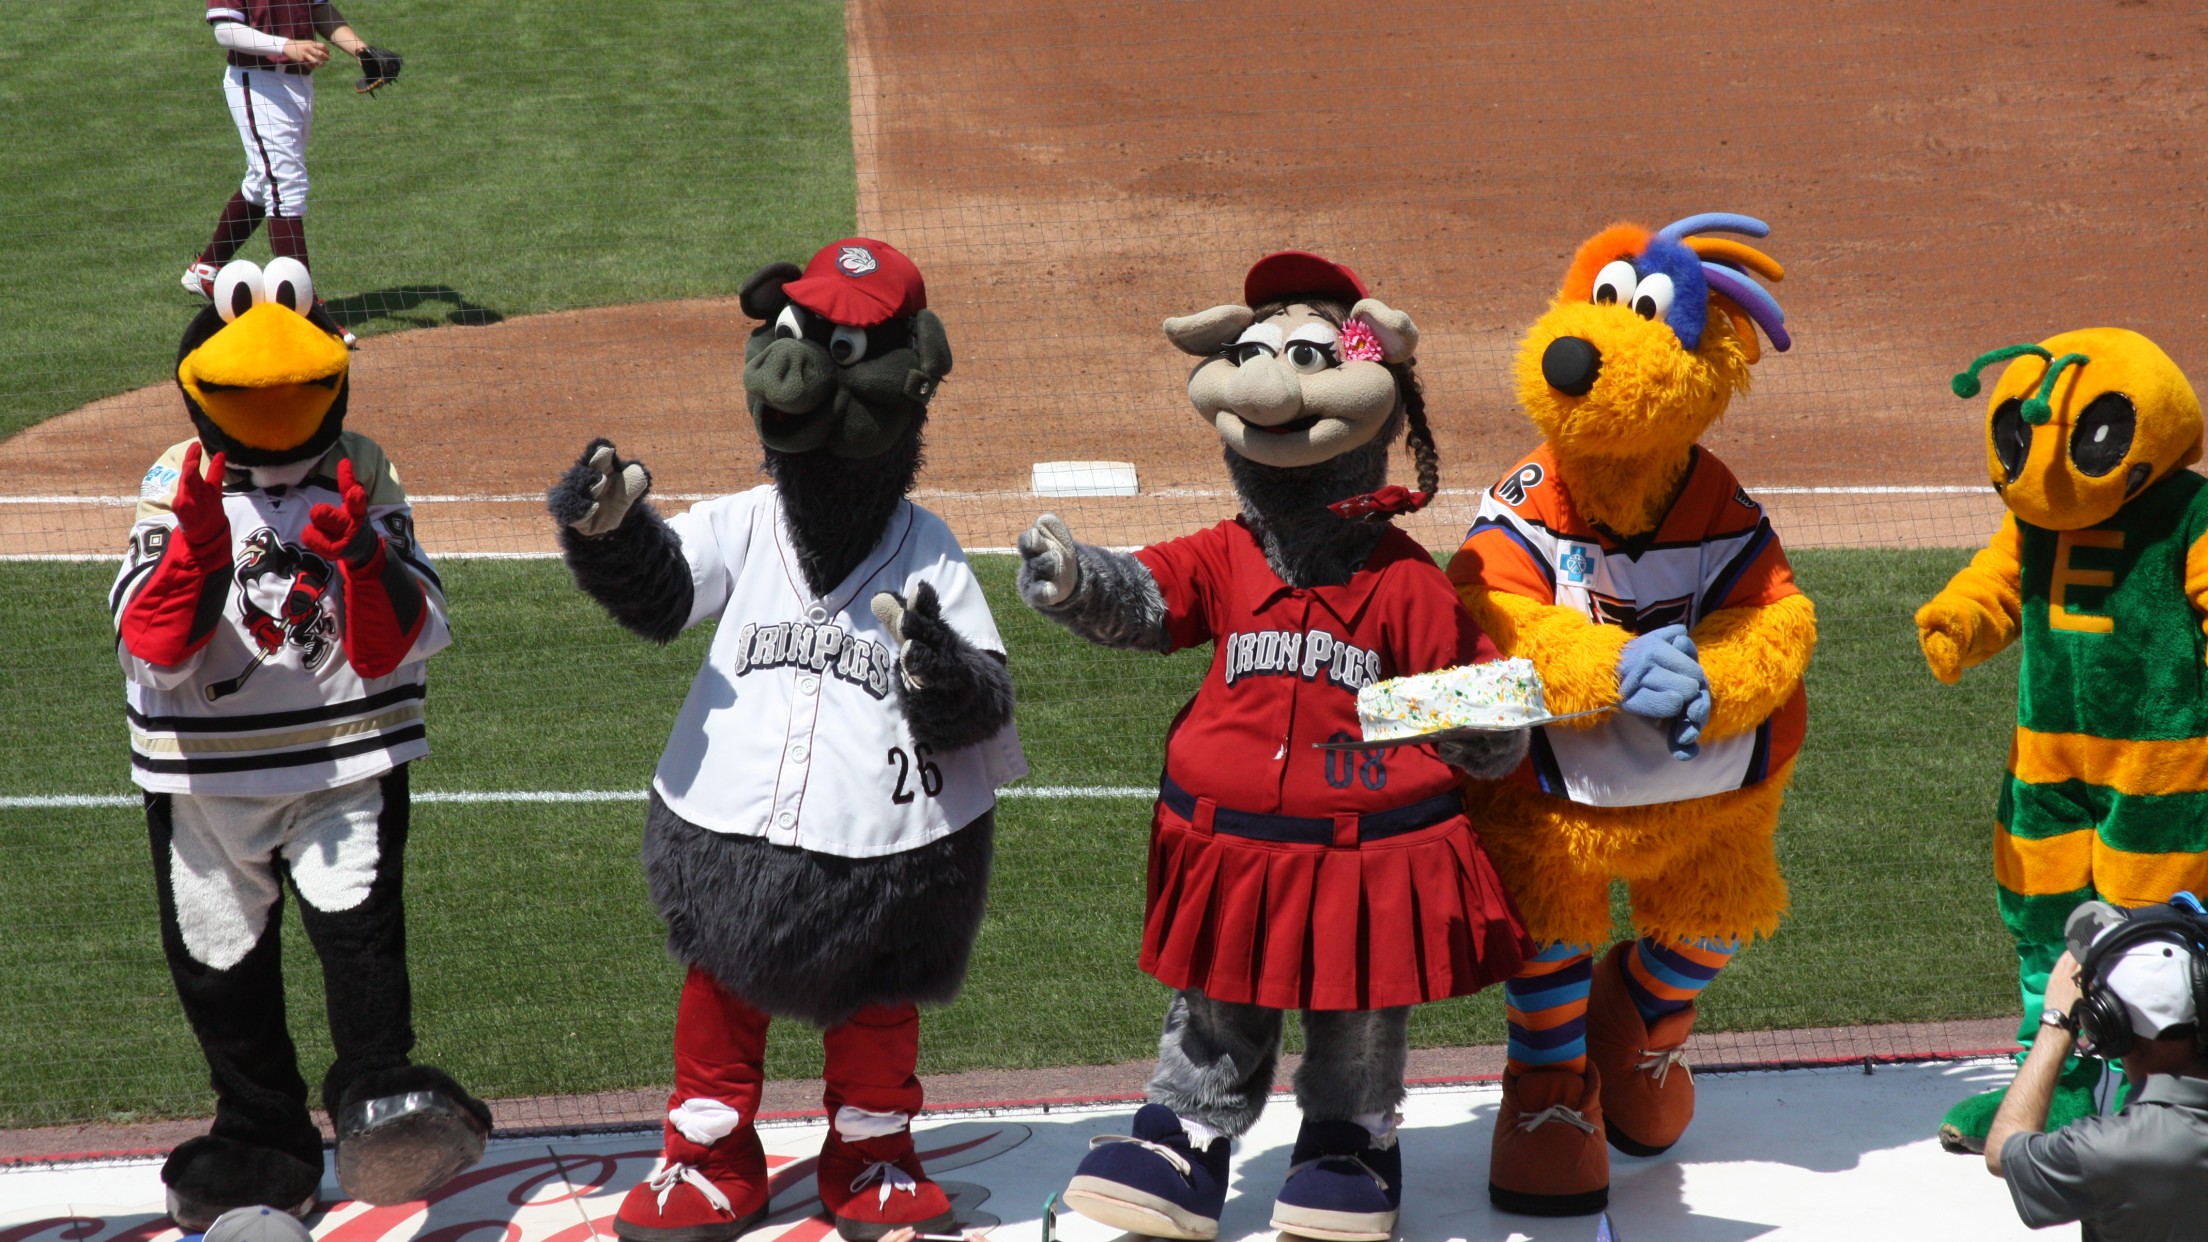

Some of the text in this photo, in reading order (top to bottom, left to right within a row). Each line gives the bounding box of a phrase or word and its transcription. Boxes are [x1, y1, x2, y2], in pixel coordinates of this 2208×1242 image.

[2049, 529, 2126, 634] E
[887, 741, 944, 805] 26
[1325, 731, 1387, 791] 08
